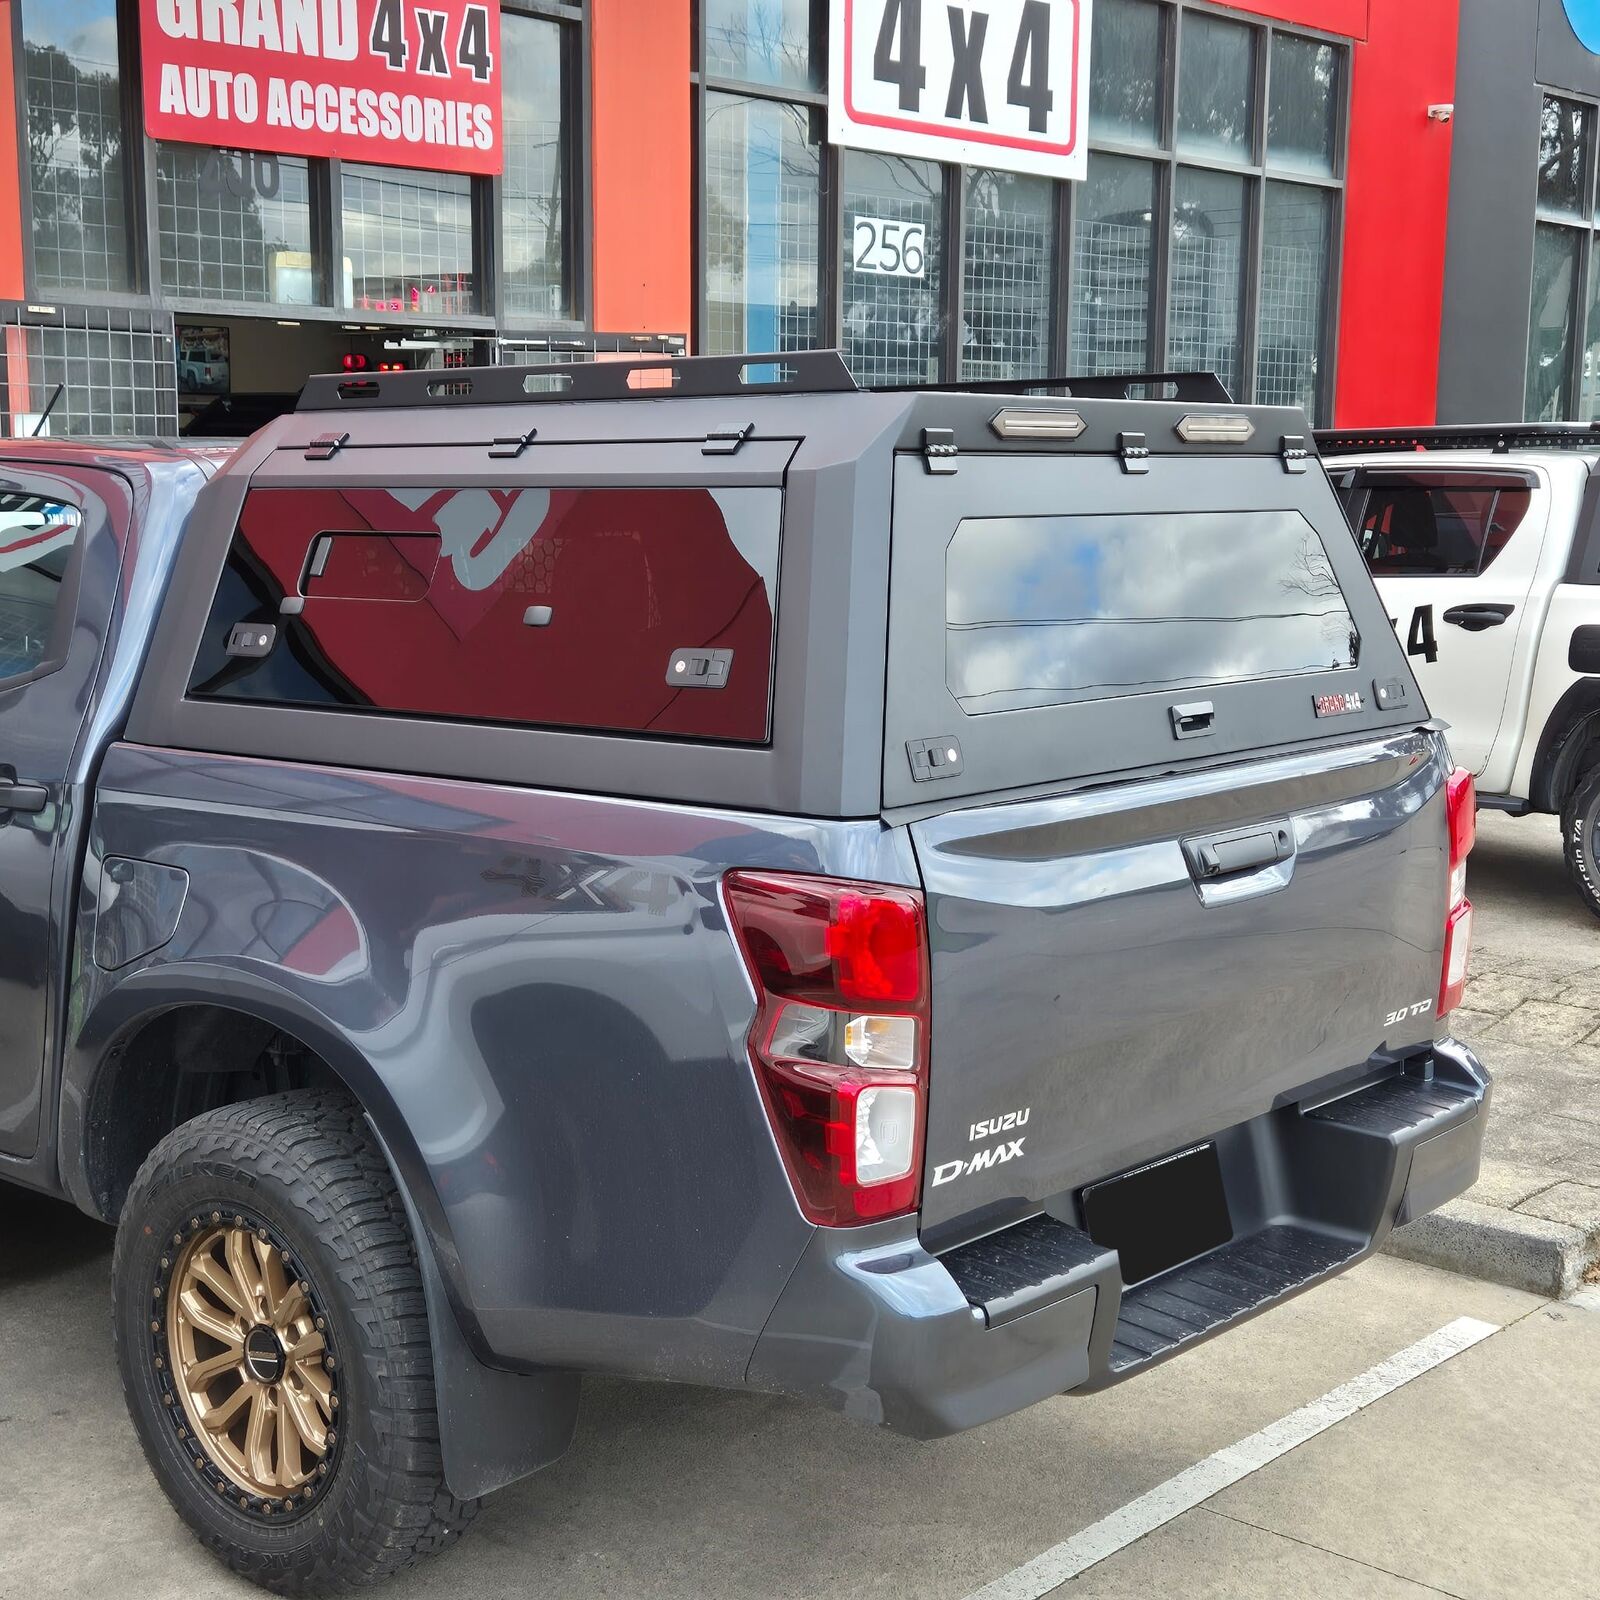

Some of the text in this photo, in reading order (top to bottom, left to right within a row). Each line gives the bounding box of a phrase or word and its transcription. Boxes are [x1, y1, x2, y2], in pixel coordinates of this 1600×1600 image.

[369, 0, 494, 84] 4x4
[873, 0, 1054, 134] 4x4
[159, 63, 494, 150] AUTO ACCESSORIES
[855, 220, 924, 275] 256
[1410, 998, 1433, 1016] TD
[969, 1107, 1030, 1142] ISUZU
